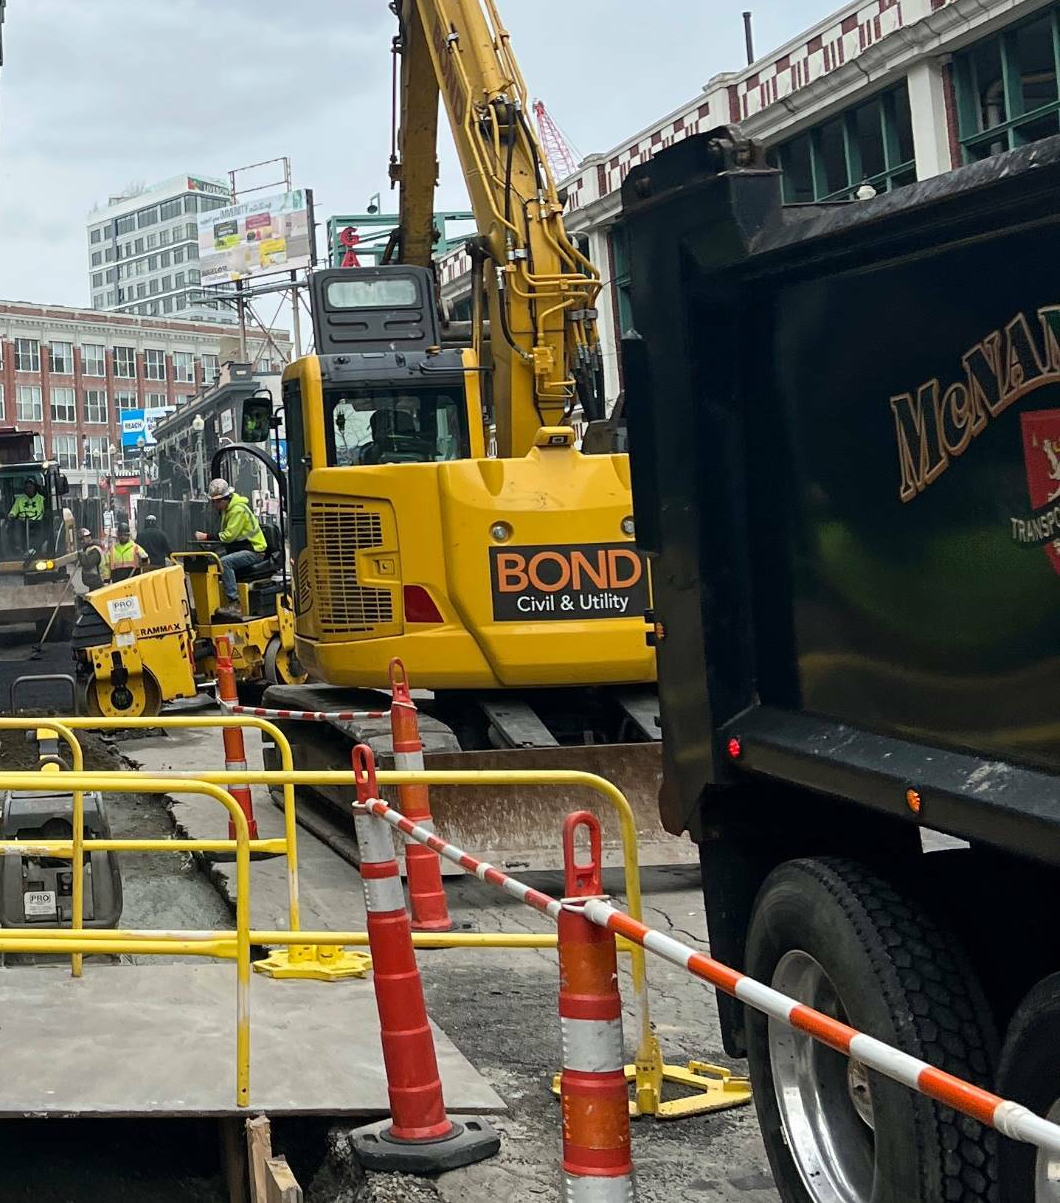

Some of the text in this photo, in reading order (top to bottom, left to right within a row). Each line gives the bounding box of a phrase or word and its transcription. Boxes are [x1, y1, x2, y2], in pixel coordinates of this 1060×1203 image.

[496, 549, 642, 593] BOND
[516, 592, 629, 613] Civil & Utility
[140, 623, 180, 636] RAMMAX
[31, 894, 50, 902] PRO
